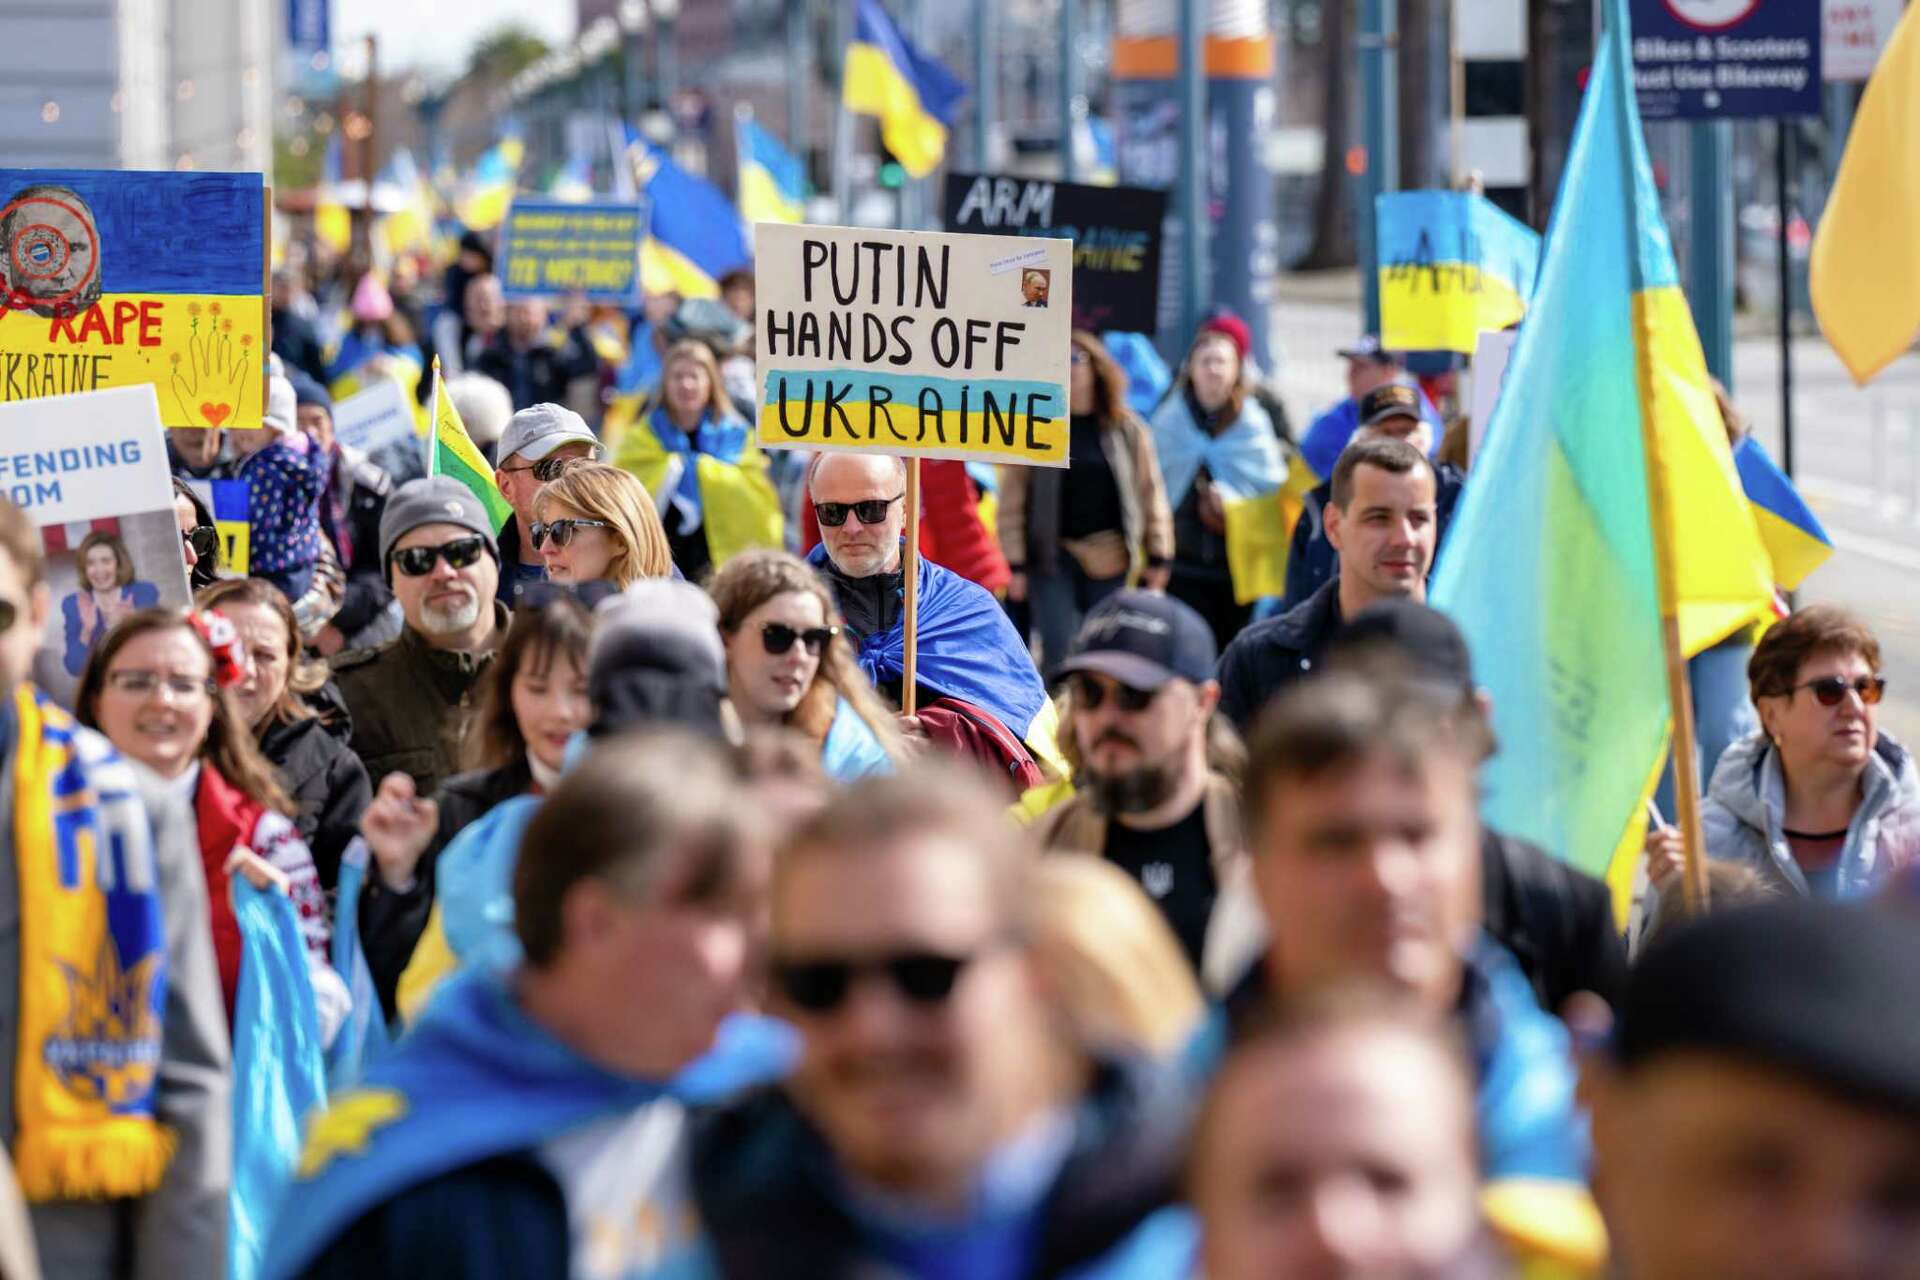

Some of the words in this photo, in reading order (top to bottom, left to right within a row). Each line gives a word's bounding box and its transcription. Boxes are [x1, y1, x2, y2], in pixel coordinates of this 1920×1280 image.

[1714, 36, 1809, 60] Scooters
[1633, 67, 1671, 89] ust
[1715, 65, 1808, 92] Bikeway
[956, 176, 1055, 228] ARM
[803, 239, 950, 309] PUTIN
[49, 300, 164, 347] RAPE
[767, 309, 915, 366] HANDS
[930, 316, 1026, 372] OFF
[0, 352, 112, 401] KRAINE
